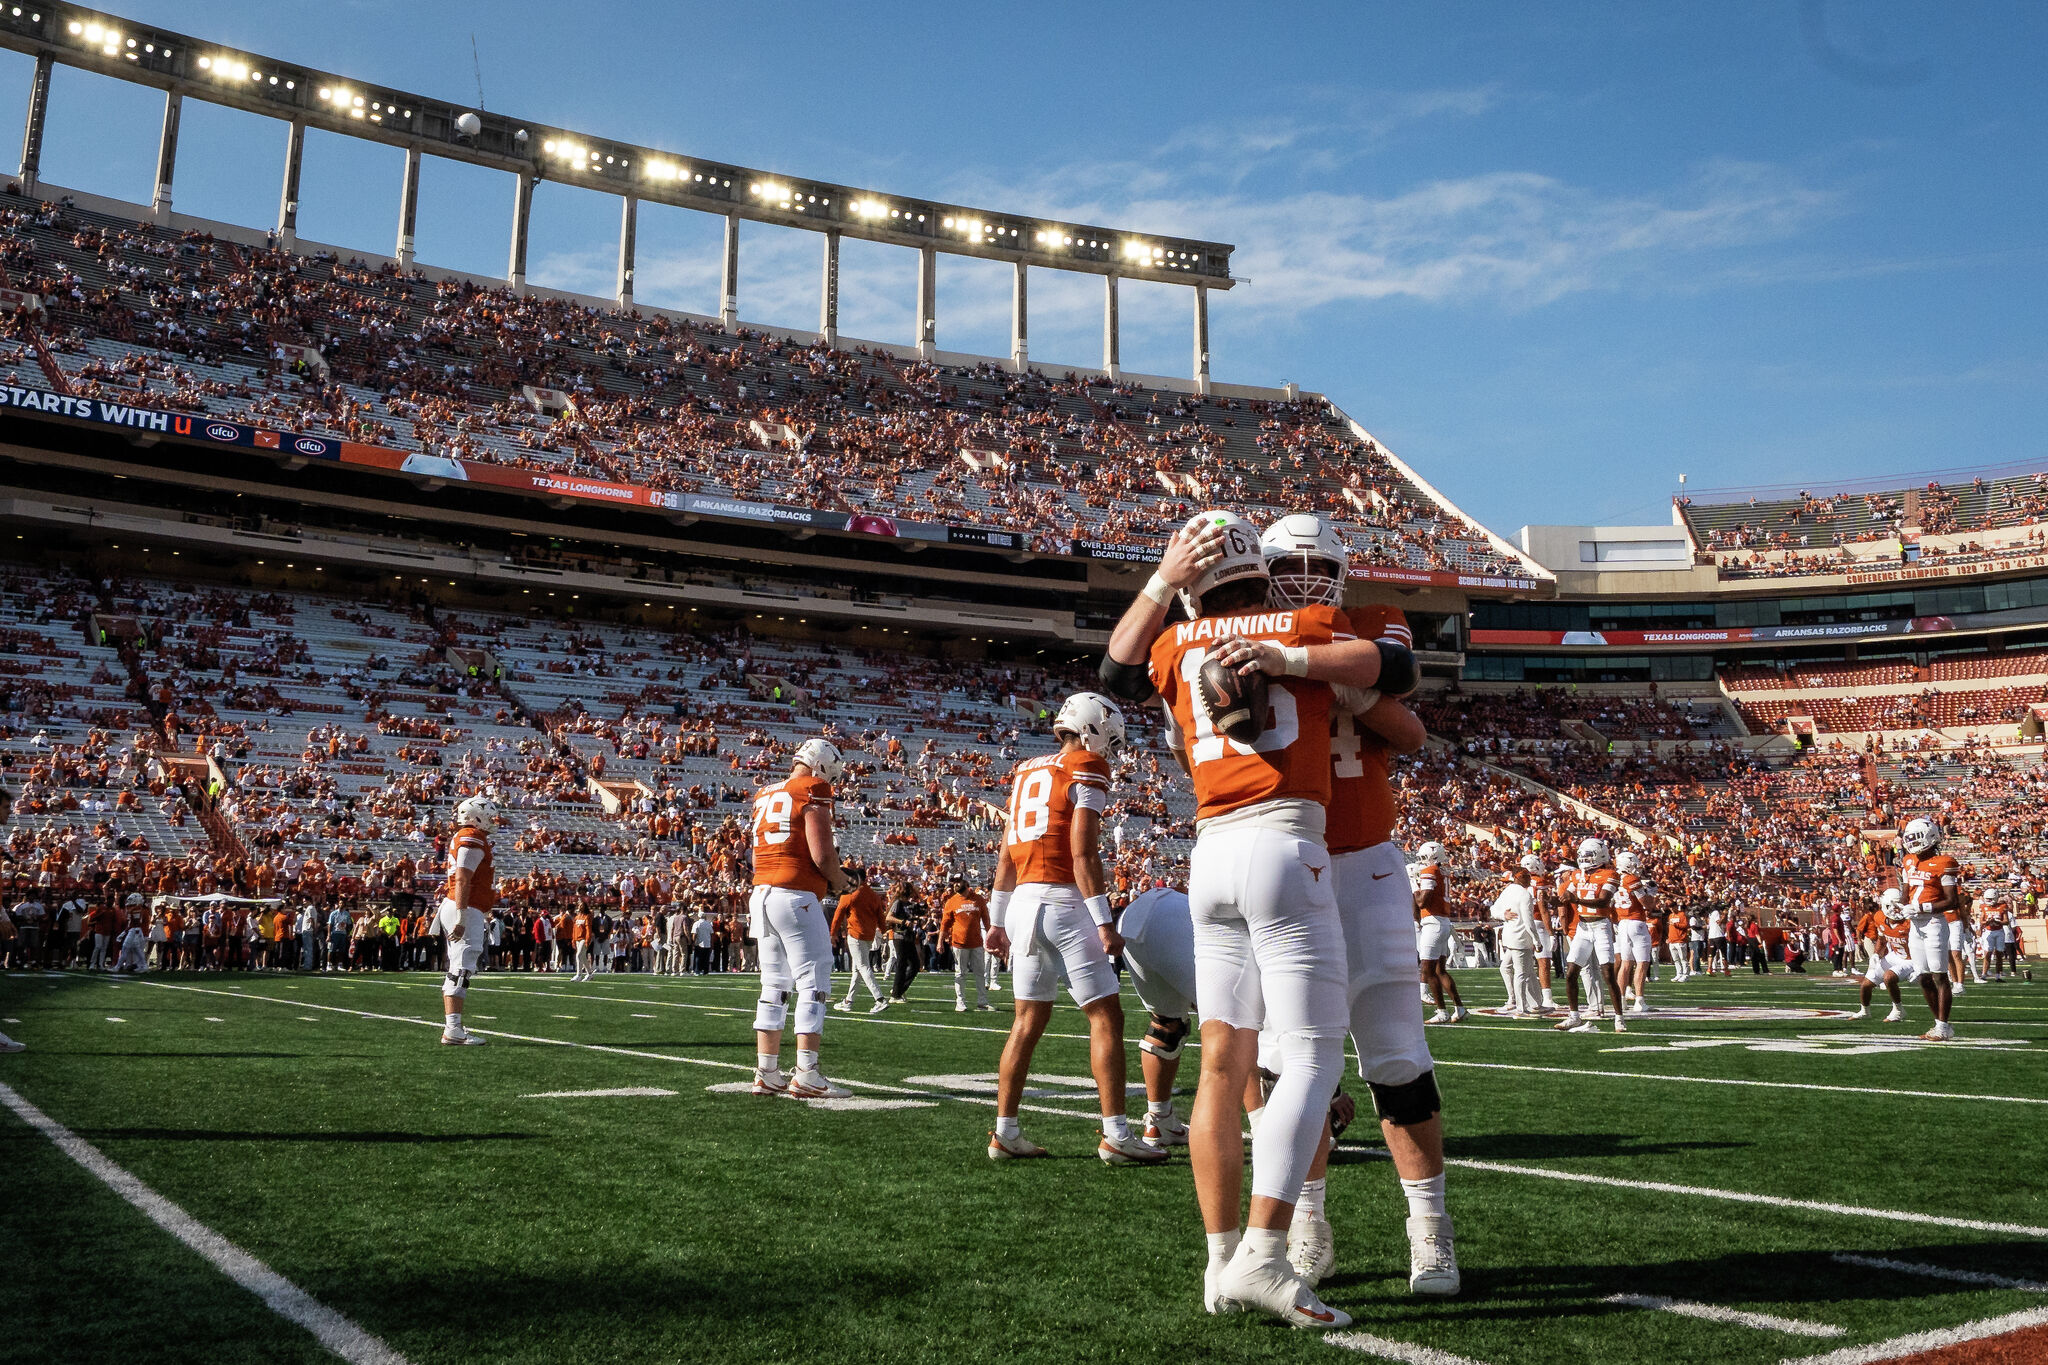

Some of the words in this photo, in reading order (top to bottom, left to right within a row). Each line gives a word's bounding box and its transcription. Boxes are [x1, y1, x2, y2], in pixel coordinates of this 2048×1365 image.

[0, 386, 92, 418] STARTS
[100, 403, 168, 431] WITH
[211, 427, 234, 438] ufcu
[300, 442, 321, 452] ufcu
[532, 477, 568, 490] TEXAS
[570, 483, 633, 499] LONGHORNS
[649, 490, 678, 508] 47:56
[693, 500, 746, 514] ARKANSAS
[747, 506, 812, 522] RAZORBACKS
[953, 532, 986, 541] DOMAIN
[1081, 541, 1101, 549] OVER
[1103, 543, 1115, 551] 130
[1117, 544, 1145, 553] STORES
[1092, 550, 1125, 560] LOCATED
[1126, 553, 1140, 561] OFF
[1214, 563, 1260, 580] LONGHORNS
[1847, 572, 1897, 584] CONFERENCE
[1901, 567, 1949, 580] CHAMPIONS
[1458, 576, 1481, 586] SCORES
[1483, 577, 1506, 588] AROUND
[1507, 579, 1518, 588] THE
[1519, 580, 1528, 589] BIG
[1530, 581, 1536, 590] 12
[1176, 612, 1294, 647] MANNING
[1675, 632, 1728, 641] LONGHORNS
[1775, 628, 1824, 637] ARKANSAS
[1826, 624, 1888, 635] RAZORBACKS
[1007, 769, 1053, 846] 18
[751, 791, 793, 847] 79
[1909, 880, 1925, 906] 7
